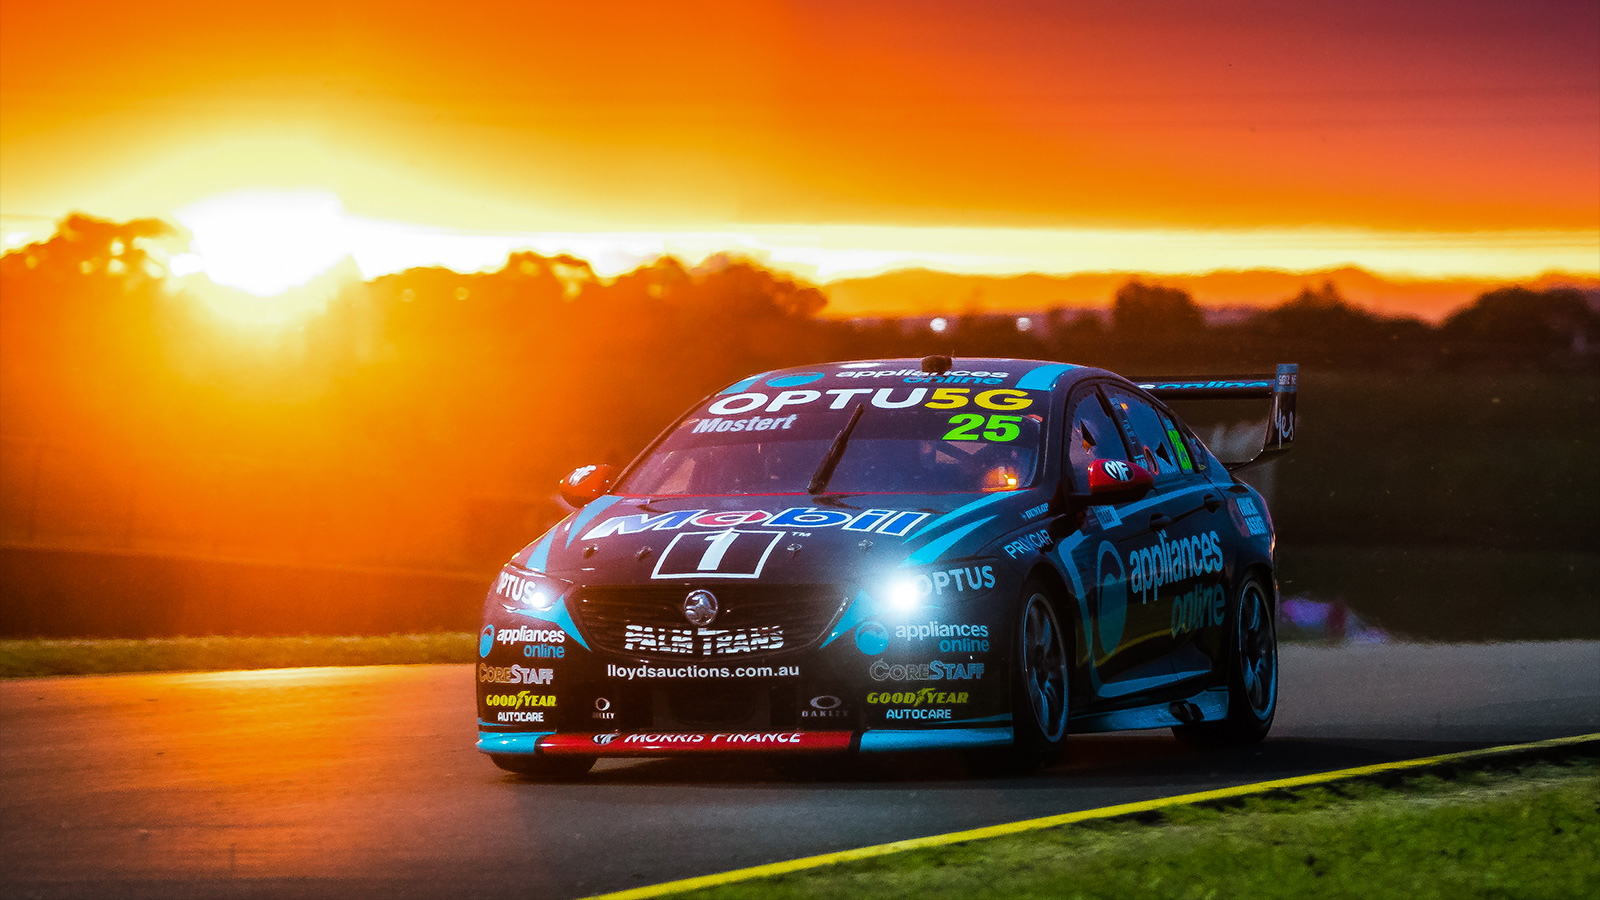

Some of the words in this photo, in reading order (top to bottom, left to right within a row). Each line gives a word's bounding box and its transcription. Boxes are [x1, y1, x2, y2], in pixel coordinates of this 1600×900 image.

[692, 414, 797, 433] Mostert
[942, 413, 1022, 442] 25
[1025, 502, 1049, 519] DUNLOP
[581, 508, 931, 541] Mobil
[1003, 529, 1054, 560] PRIXCAR
[1129, 529, 1223, 604] appliances
[915, 565, 996, 599] OPTUS
[1171, 583, 1225, 640] online
[496, 625, 566, 645] appliances
[624, 625, 693, 654] PALM
[697, 626, 784, 656] TRANS
[895, 620, 989, 642] appliances
[523, 643, 565, 658] online
[938, 638, 990, 653] online
[607, 664, 800, 680] lloydsauctions.com.au
[497, 711, 544, 722] AUTOCARE
[886, 709, 952, 719] AUTOCARE
